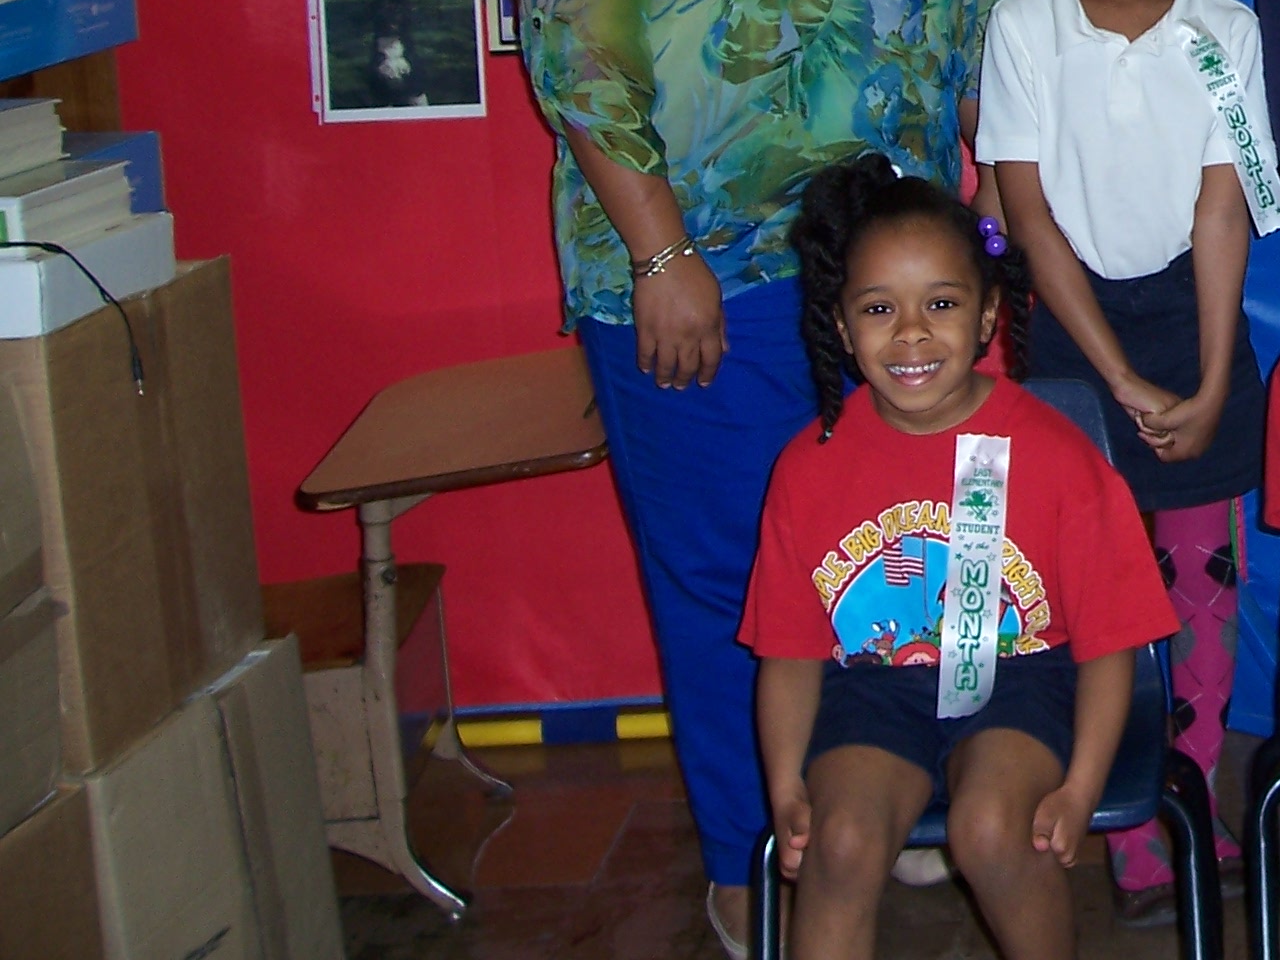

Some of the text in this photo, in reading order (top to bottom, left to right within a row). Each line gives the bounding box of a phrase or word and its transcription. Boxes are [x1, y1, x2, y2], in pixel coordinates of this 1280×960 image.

[1224, 103, 1275, 210] MONTH
[840, 521, 882, 565] BIG
[879, 502, 950, 542] DREAM
[1001, 538, 1046, 608] RIGHT
[955, 521, 1001, 536] STUDENT
[954, 558, 989, 692] MONTH
